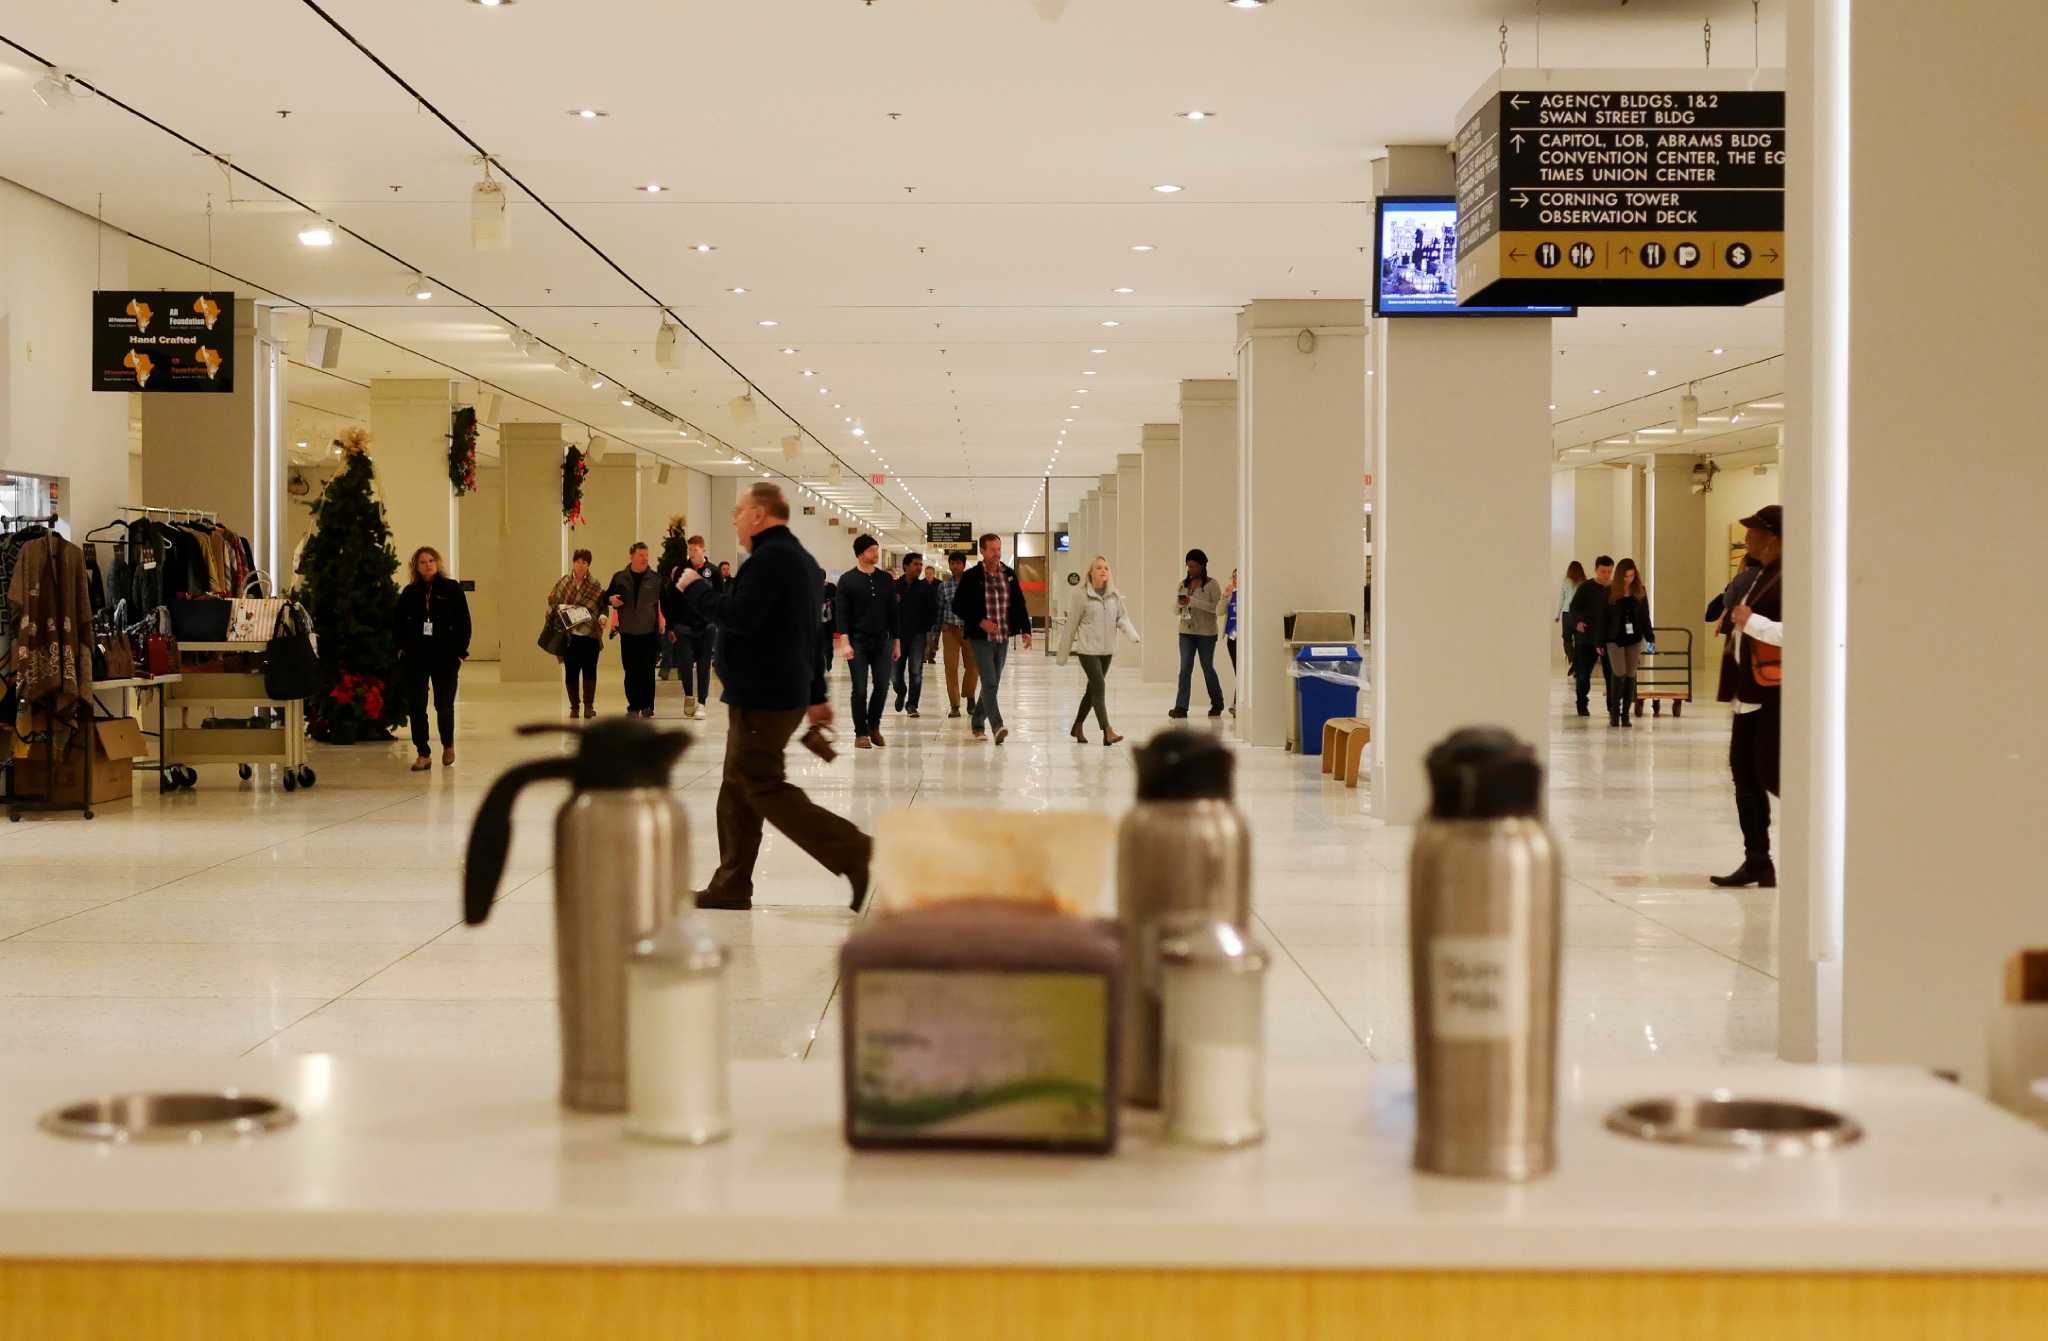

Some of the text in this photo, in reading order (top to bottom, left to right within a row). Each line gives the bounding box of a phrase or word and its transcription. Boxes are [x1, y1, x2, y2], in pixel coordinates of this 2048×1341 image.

[1540, 94, 1718, 108] AGENCY BLDGS. 1&2
[1539, 110, 1695, 124] SWAN STREET BLDG
[1539, 133, 1772, 148] CAPITOL, LOB, ABRAMS BLDG
[1539, 150, 1785, 166] CONVENTION CENTER, THE EG
[1539, 168, 1716, 182] TIMES UNION CENTER
[1539, 192, 1680, 207] CORNING TOWER
[1539, 209, 1698, 224] OBSERVATION DECK
[169, 317, 205, 326] Foundation
[129, 335, 197, 344] Hand Crafted
